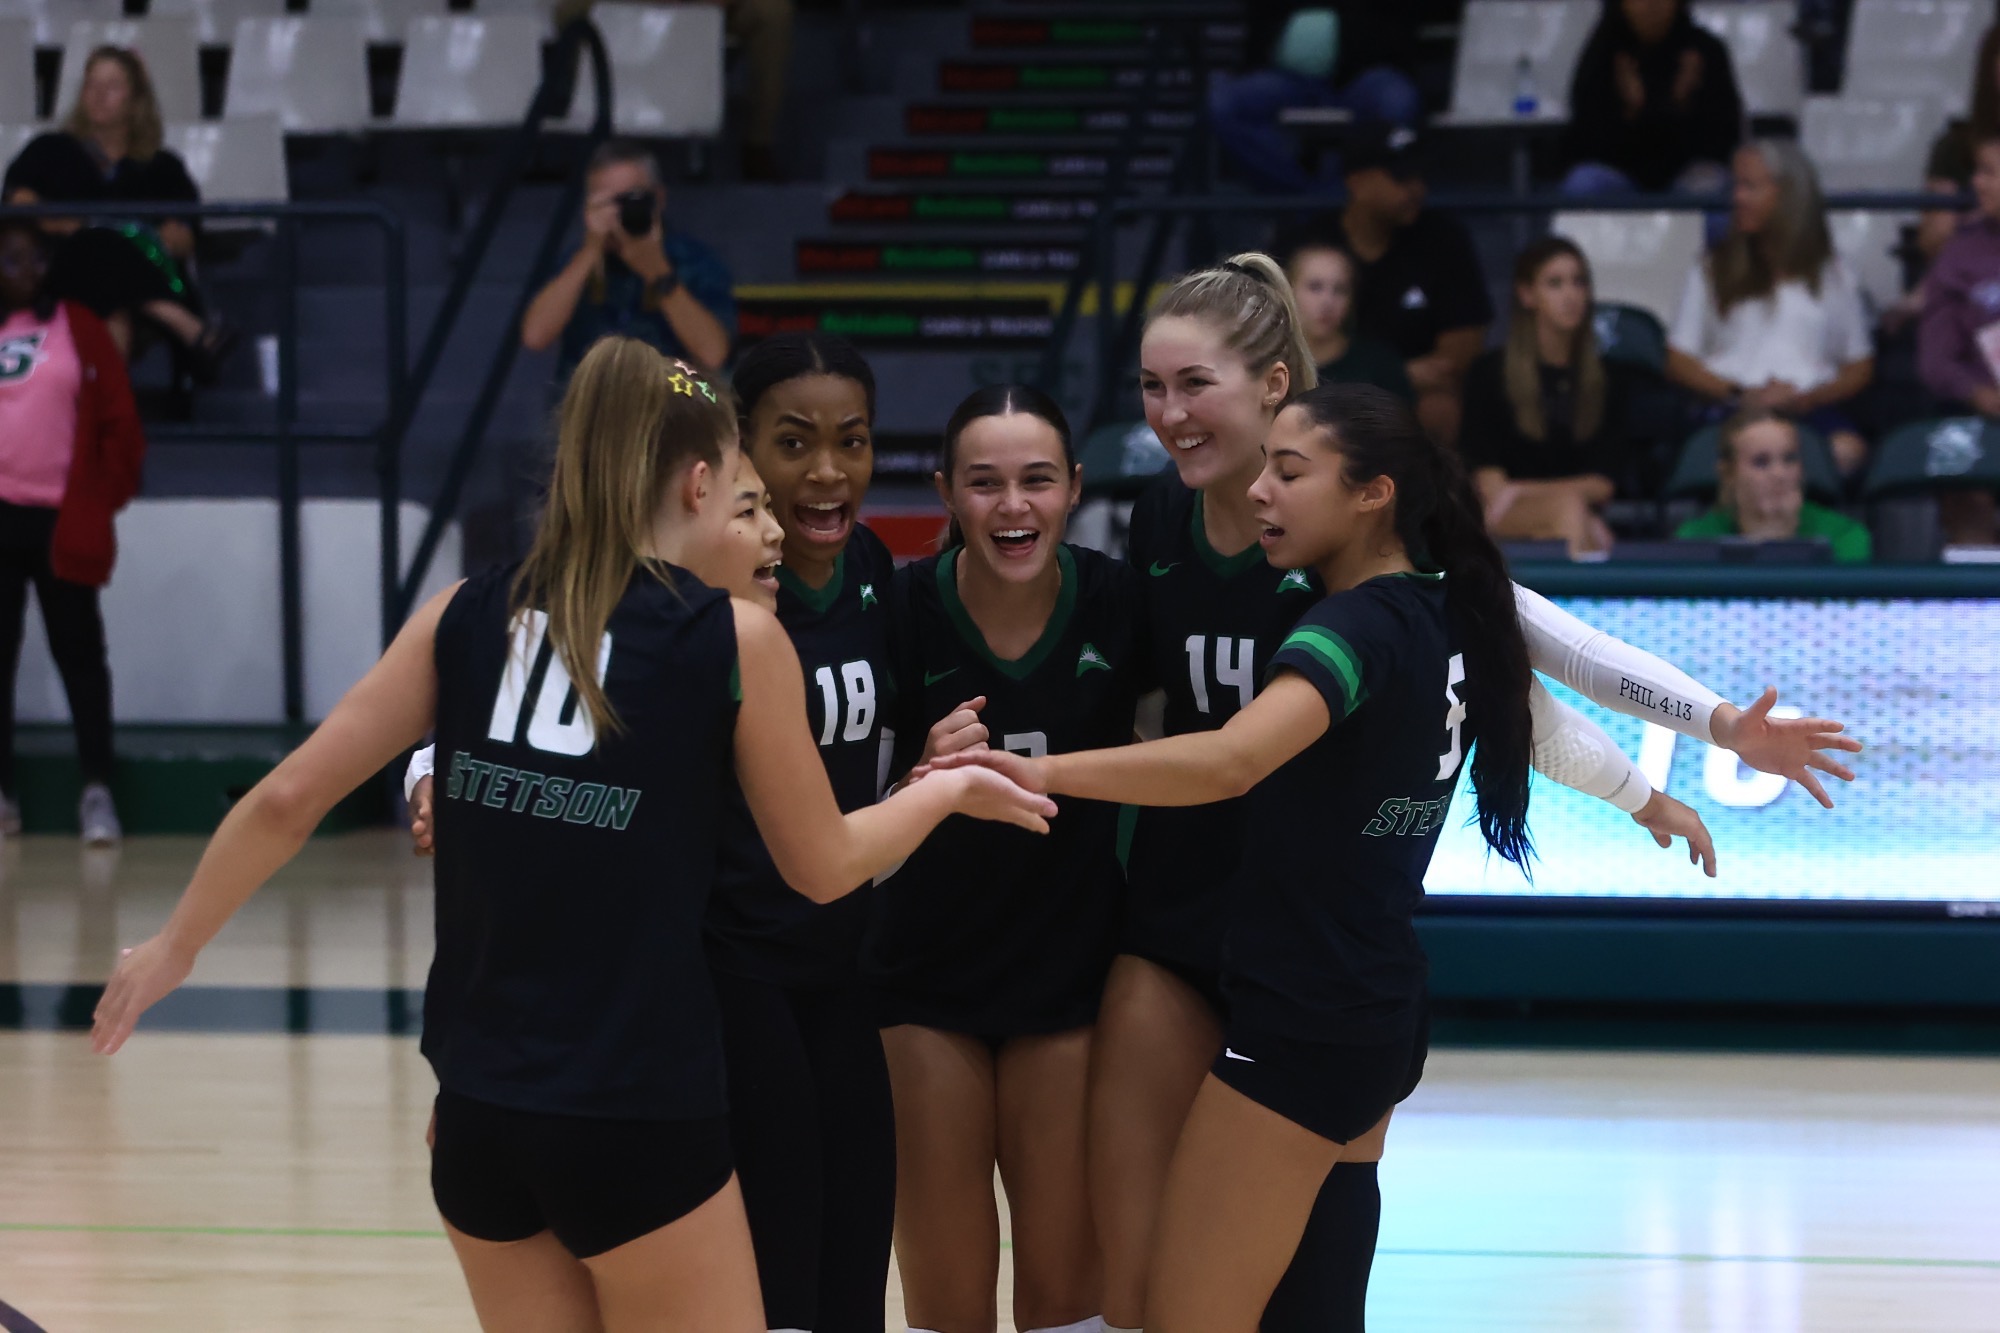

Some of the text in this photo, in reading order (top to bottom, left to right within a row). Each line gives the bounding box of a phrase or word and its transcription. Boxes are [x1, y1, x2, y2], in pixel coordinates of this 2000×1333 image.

[815, 660, 876, 746] 18
[1185, 634, 1255, 714] 14
[1619, 677, 1693, 721] PHIL 4:13
[447, 751, 642, 831] STETSON
